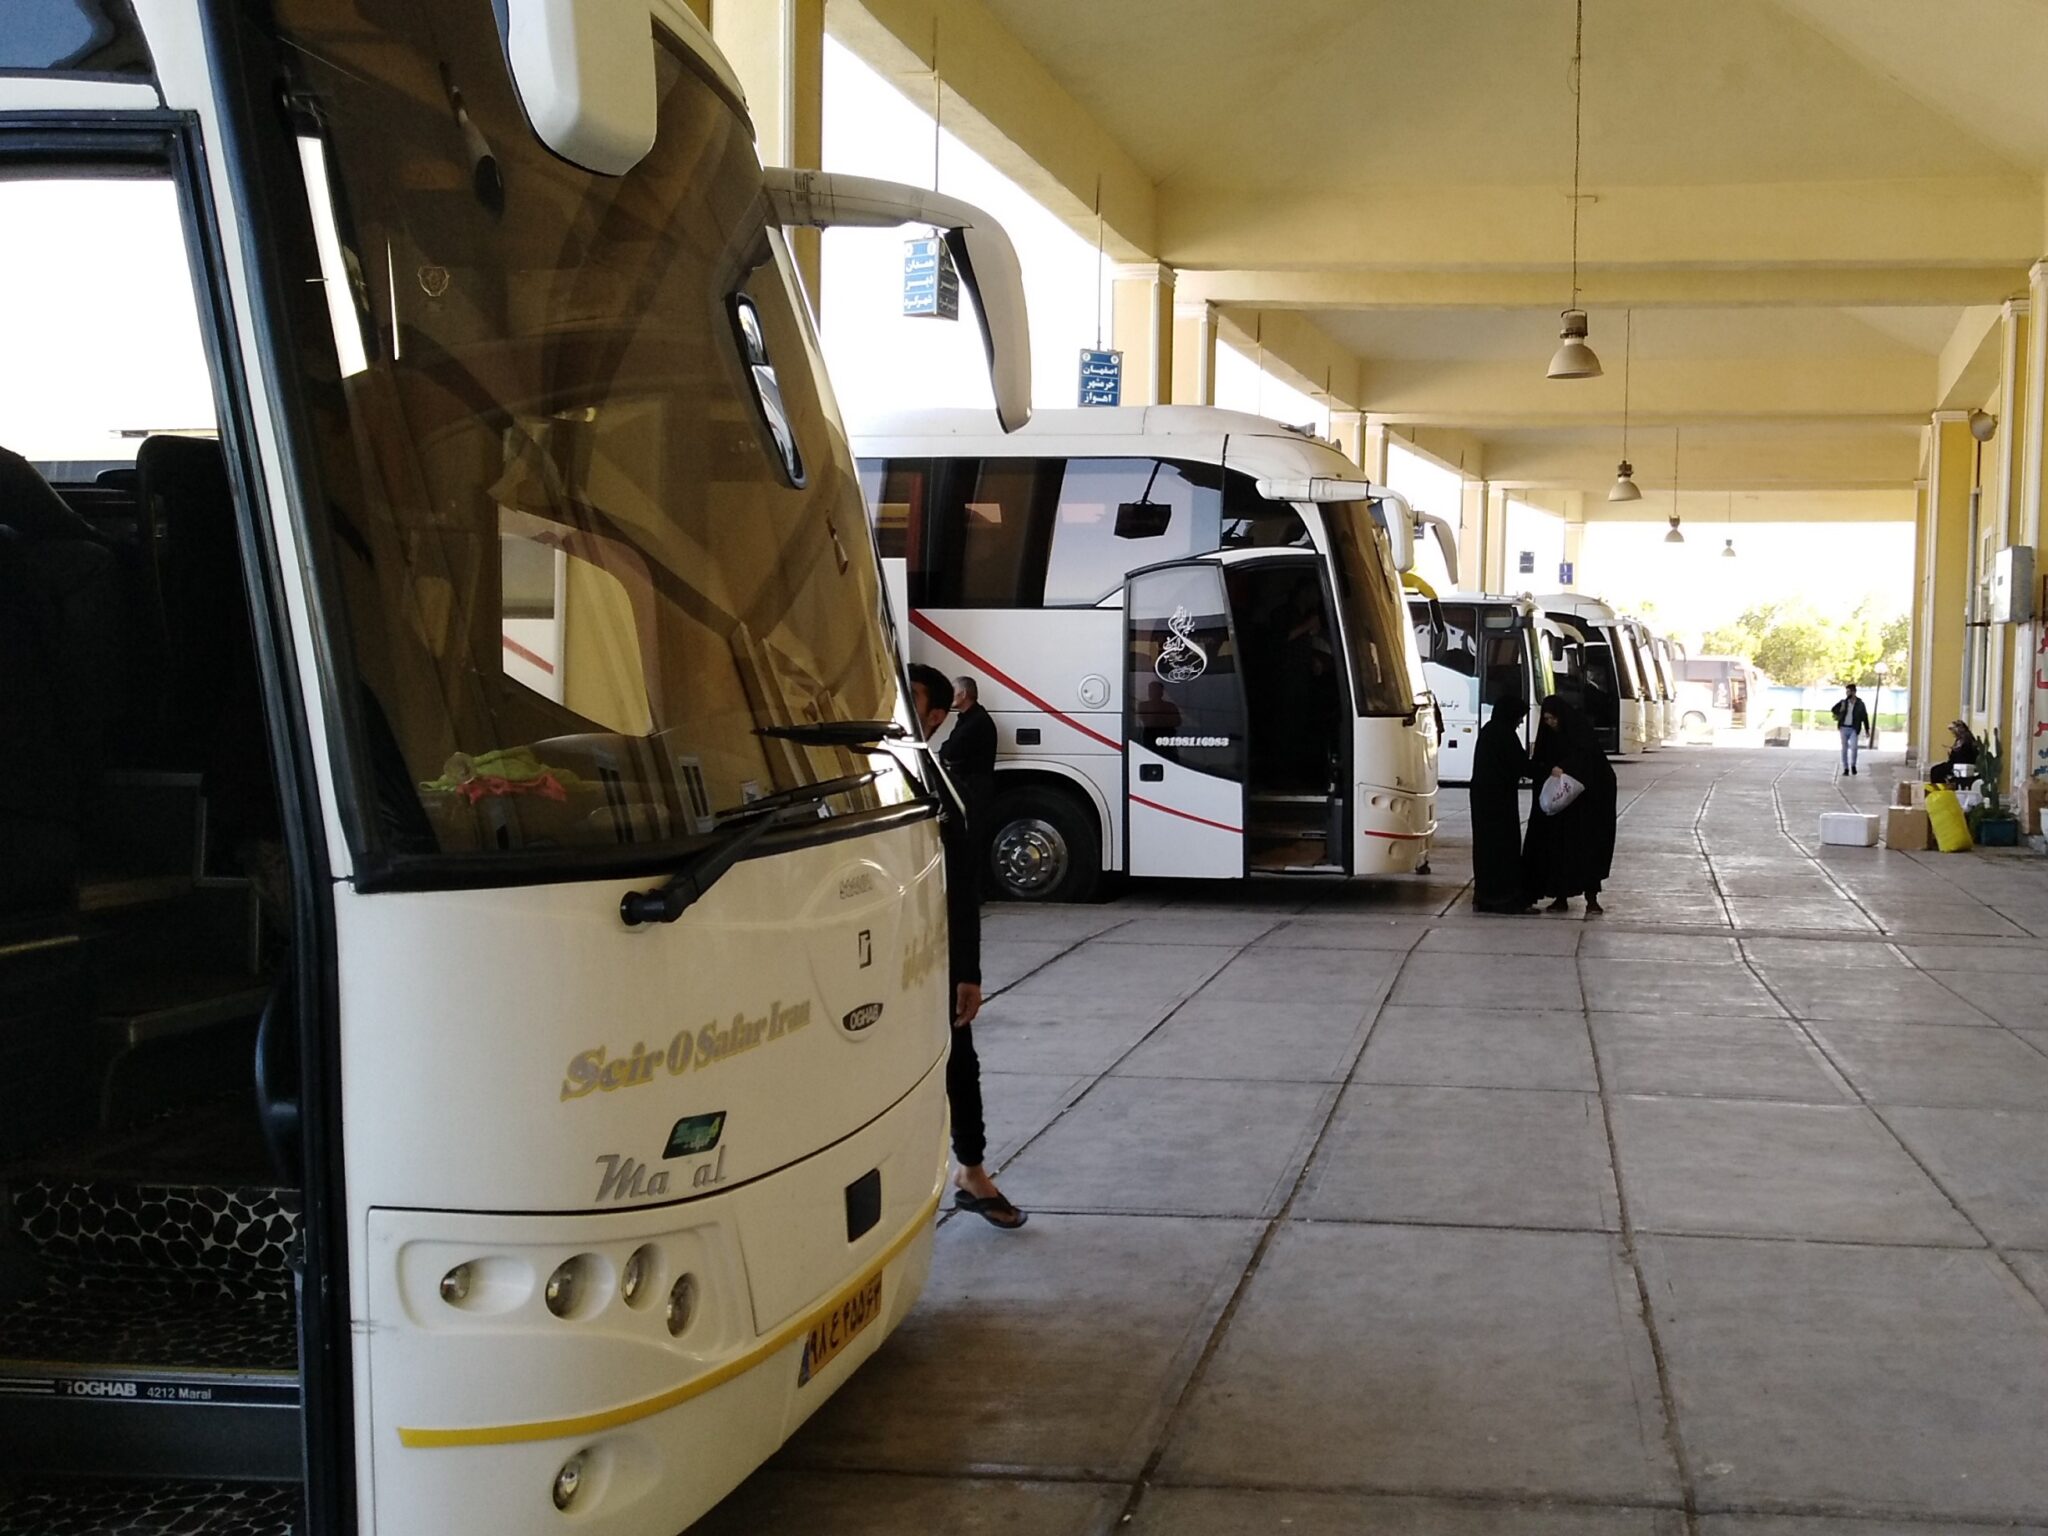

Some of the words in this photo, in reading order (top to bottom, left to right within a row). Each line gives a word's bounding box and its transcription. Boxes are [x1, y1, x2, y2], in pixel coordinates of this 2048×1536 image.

[1083, 365, 1118, 375] اصفهان
[1086, 379, 1115, 391] خرمشهر
[1084, 391, 1112, 404] اهواز
[147, 1387, 175, 1399] 4212
[178, 1388, 212, 1400] Maral
